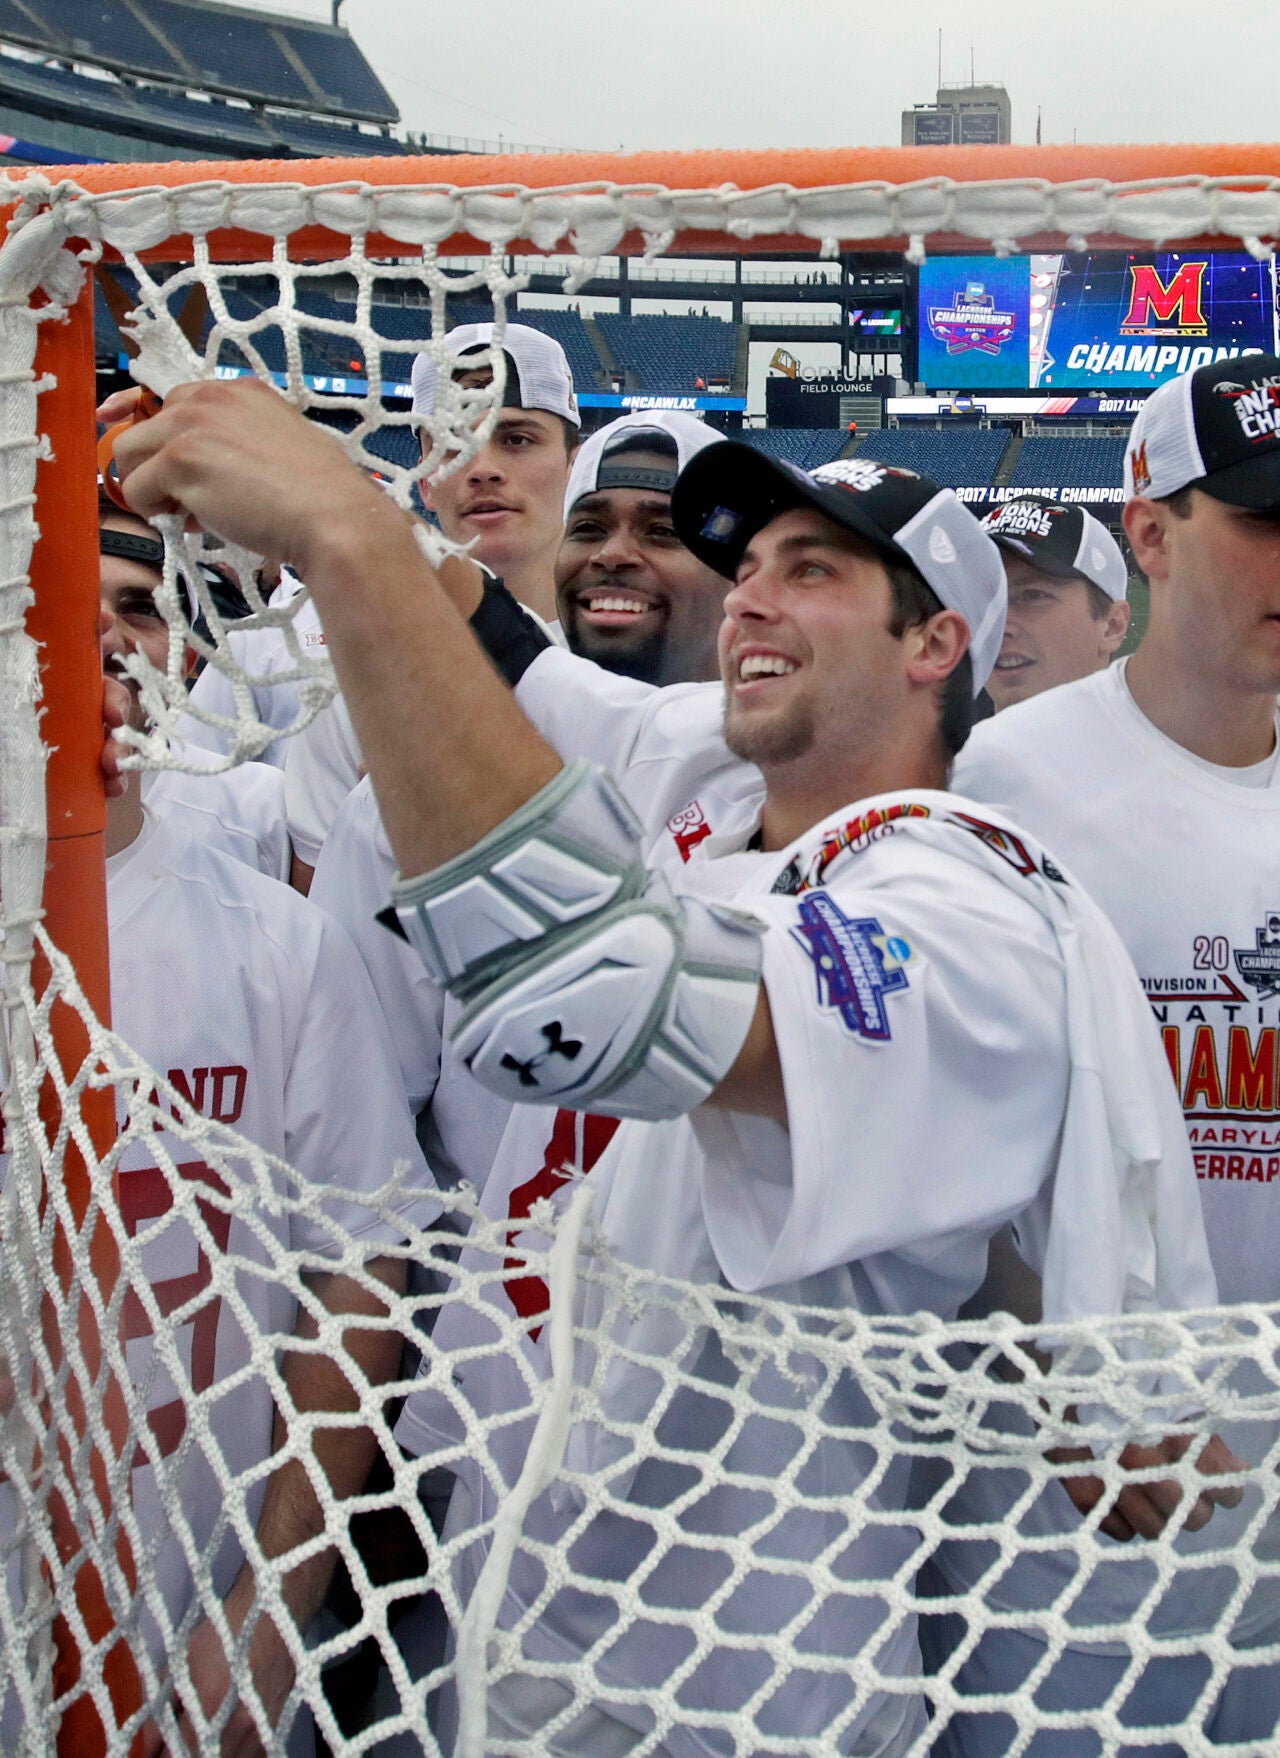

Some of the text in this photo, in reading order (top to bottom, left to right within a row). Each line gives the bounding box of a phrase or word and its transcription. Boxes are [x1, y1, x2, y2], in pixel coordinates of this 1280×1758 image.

[934, 311, 1012, 326] CHAMPIONSHIPS
[801, 365, 874, 382] OPTUM
[800, 383, 872, 393] FIELD LOUNGE
[621, 396, 697, 410] #NCAAWLAX
[1099, 399, 1124, 412] 2017
[956, 486, 987, 503] 2017
[1193, 936, 1229, 971] 20
